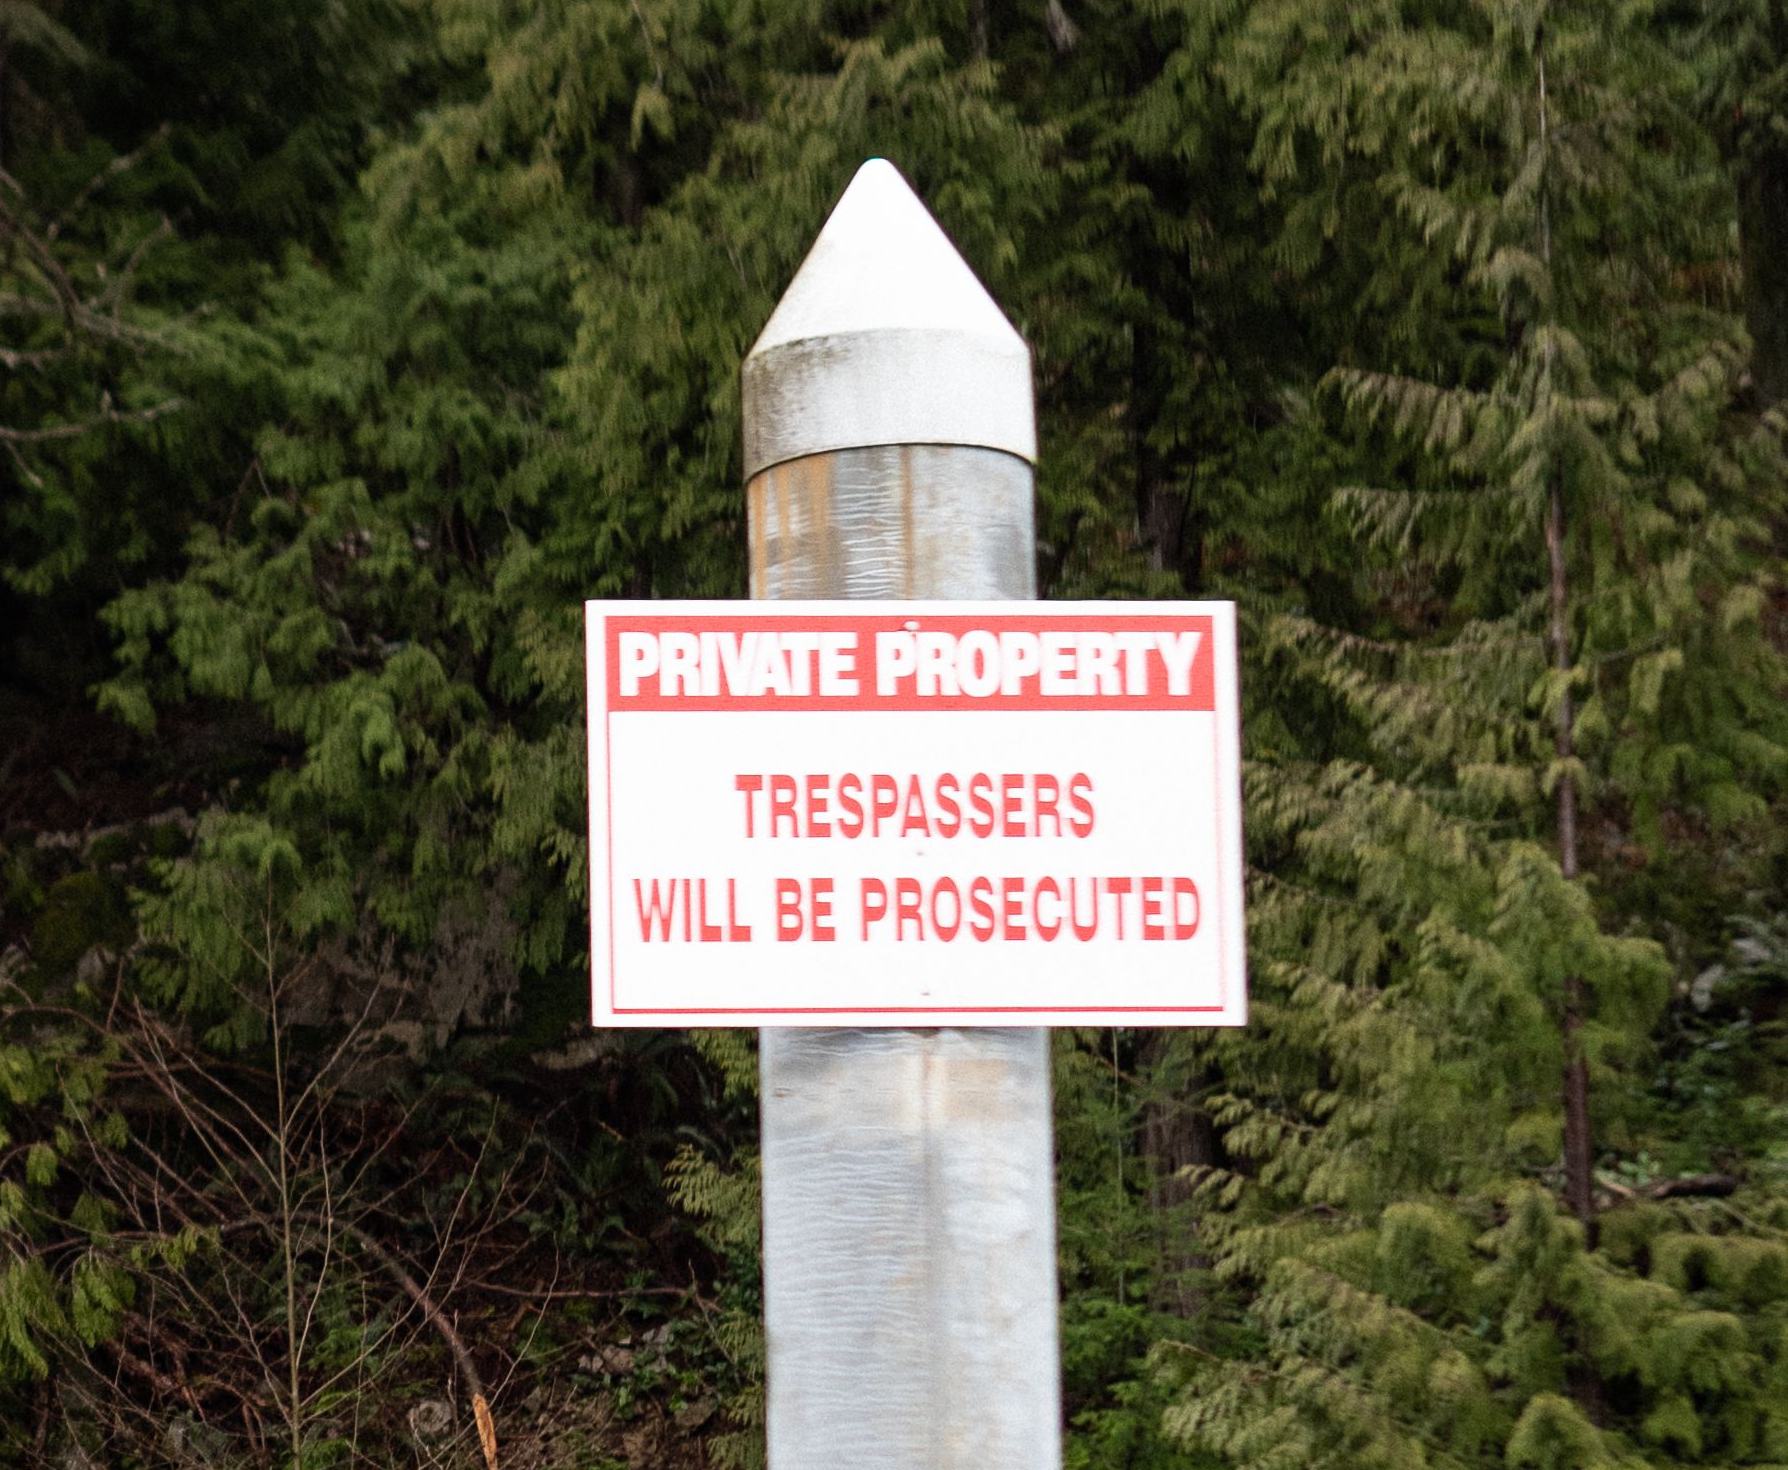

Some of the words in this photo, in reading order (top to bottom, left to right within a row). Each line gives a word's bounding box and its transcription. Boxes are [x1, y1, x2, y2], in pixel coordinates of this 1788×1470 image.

[618, 631, 859, 697] PRIVATE
[876, 629, 1200, 697] PROPERTY
[735, 772, 1095, 838] TRESPASSERS
[634, 878, 752, 942] WILL
[776, 877, 835, 942] BE
[861, 875, 1202, 942] PROSECUTED
